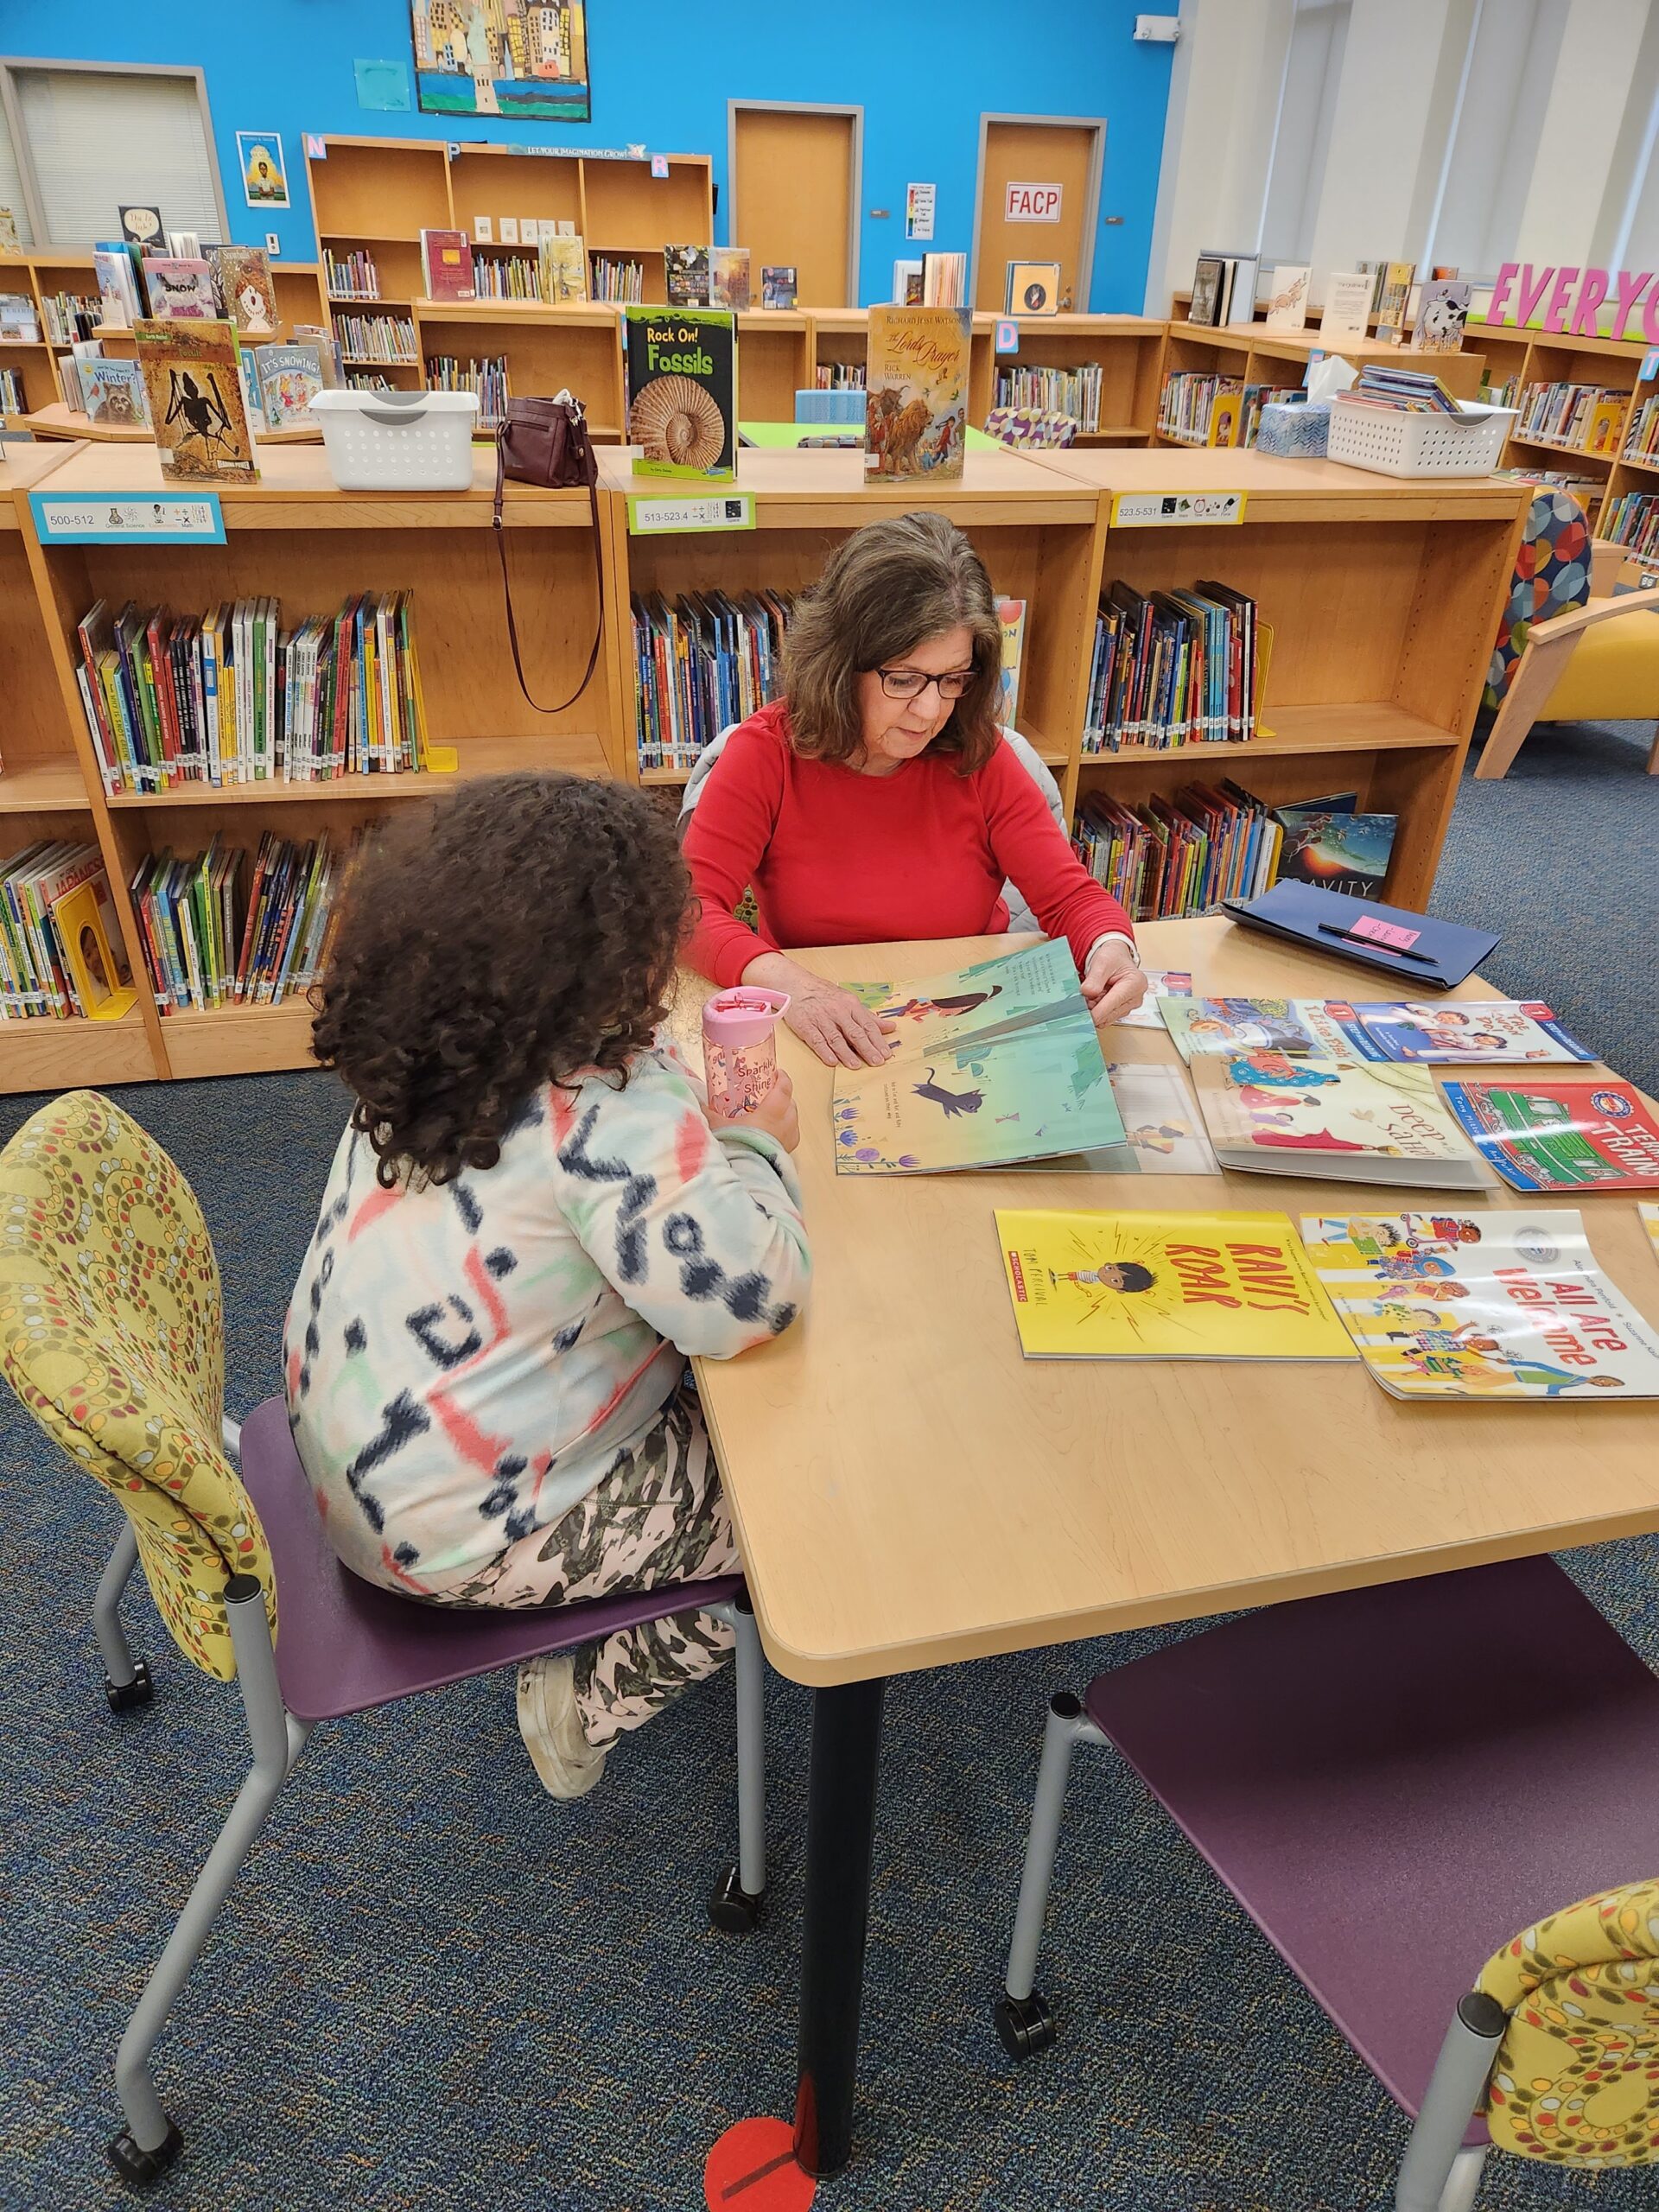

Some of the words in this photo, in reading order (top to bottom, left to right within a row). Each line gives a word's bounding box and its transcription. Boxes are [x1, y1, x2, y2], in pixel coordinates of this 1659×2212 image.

[308, 136, 323, 156] N
[448, 143, 461, 162] P
[528, 146, 539, 155] LET
[541, 147, 560, 156] YOUR
[560, 147, 603, 157] IMAGINATION
[603, 149, 627, 159] GROW!
[653, 155, 669, 175] R
[1009, 190, 1058, 215] FACP
[166, 283, 196, 293] SNOW
[887, 315, 917, 325] RICHARD
[917, 316, 933, 326] JESSE
[935, 316, 962, 325] WATSON
[646, 327, 674, 343] Rock
[677, 327, 698, 344] On!
[999, 322, 1017, 349] D
[648, 344, 714, 375] Fossils
[886, 333, 899, 343] The
[912, 340, 960, 370] Prayer
[261, 358, 278, 373] IT'S
[280, 355, 320, 374] SNOWING!
[95, 371, 136, 385] Winter?
[884, 372, 911, 380] WARREN
[50, 515, 95, 525] 500-512
[645, 512, 688, 522] 513-523.4
[1120, 508, 1156, 517] 523.5-531
[110, 695, 120, 708] WHY
[115, 720, 125, 736] SNOT
[118, 740, 130, 760] GREEN?
[1309, 1014, 1332, 1037] Like
[1476, 1016, 1504, 1032] DO!
[1489, 1007, 1524, 1037] KWON
[1510, 1014, 1529, 1031] TAE
[1346, 1023, 1359, 1034] STEP
[1359, 1040, 1381, 1058] READING
[1545, 1022, 1560, 1033] STEP
[1566, 1037, 1589, 1057] READING
[738, 1058, 774, 1077] Sparkle
[744, 1077, 771, 1094] Shine
[1454, 1096, 1467, 1113] Tony
[1591, 1121, 1659, 1176] TRAINS
[1489, 1150, 1498, 1159] Ant
[1498, 1159, 1517, 1176] Parker
[1023, 1249, 1038, 1264] TOM
[1012, 1257, 1027, 1301] SCHOLASTIC
[1165, 1244, 1243, 1309] ROAR
[1225, 1243, 1311, 1317] RAVI'S
[1029, 1269, 1047, 1306] PERCIVAL
[1545, 1282, 1598, 1305] All
[1493, 1267, 1597, 1365] Welcome
[1594, 1288, 1618, 1309] Penfold
[1623, 1322, 1646, 1345] Suzanne
[1570, 1313, 1628, 1351] Are
